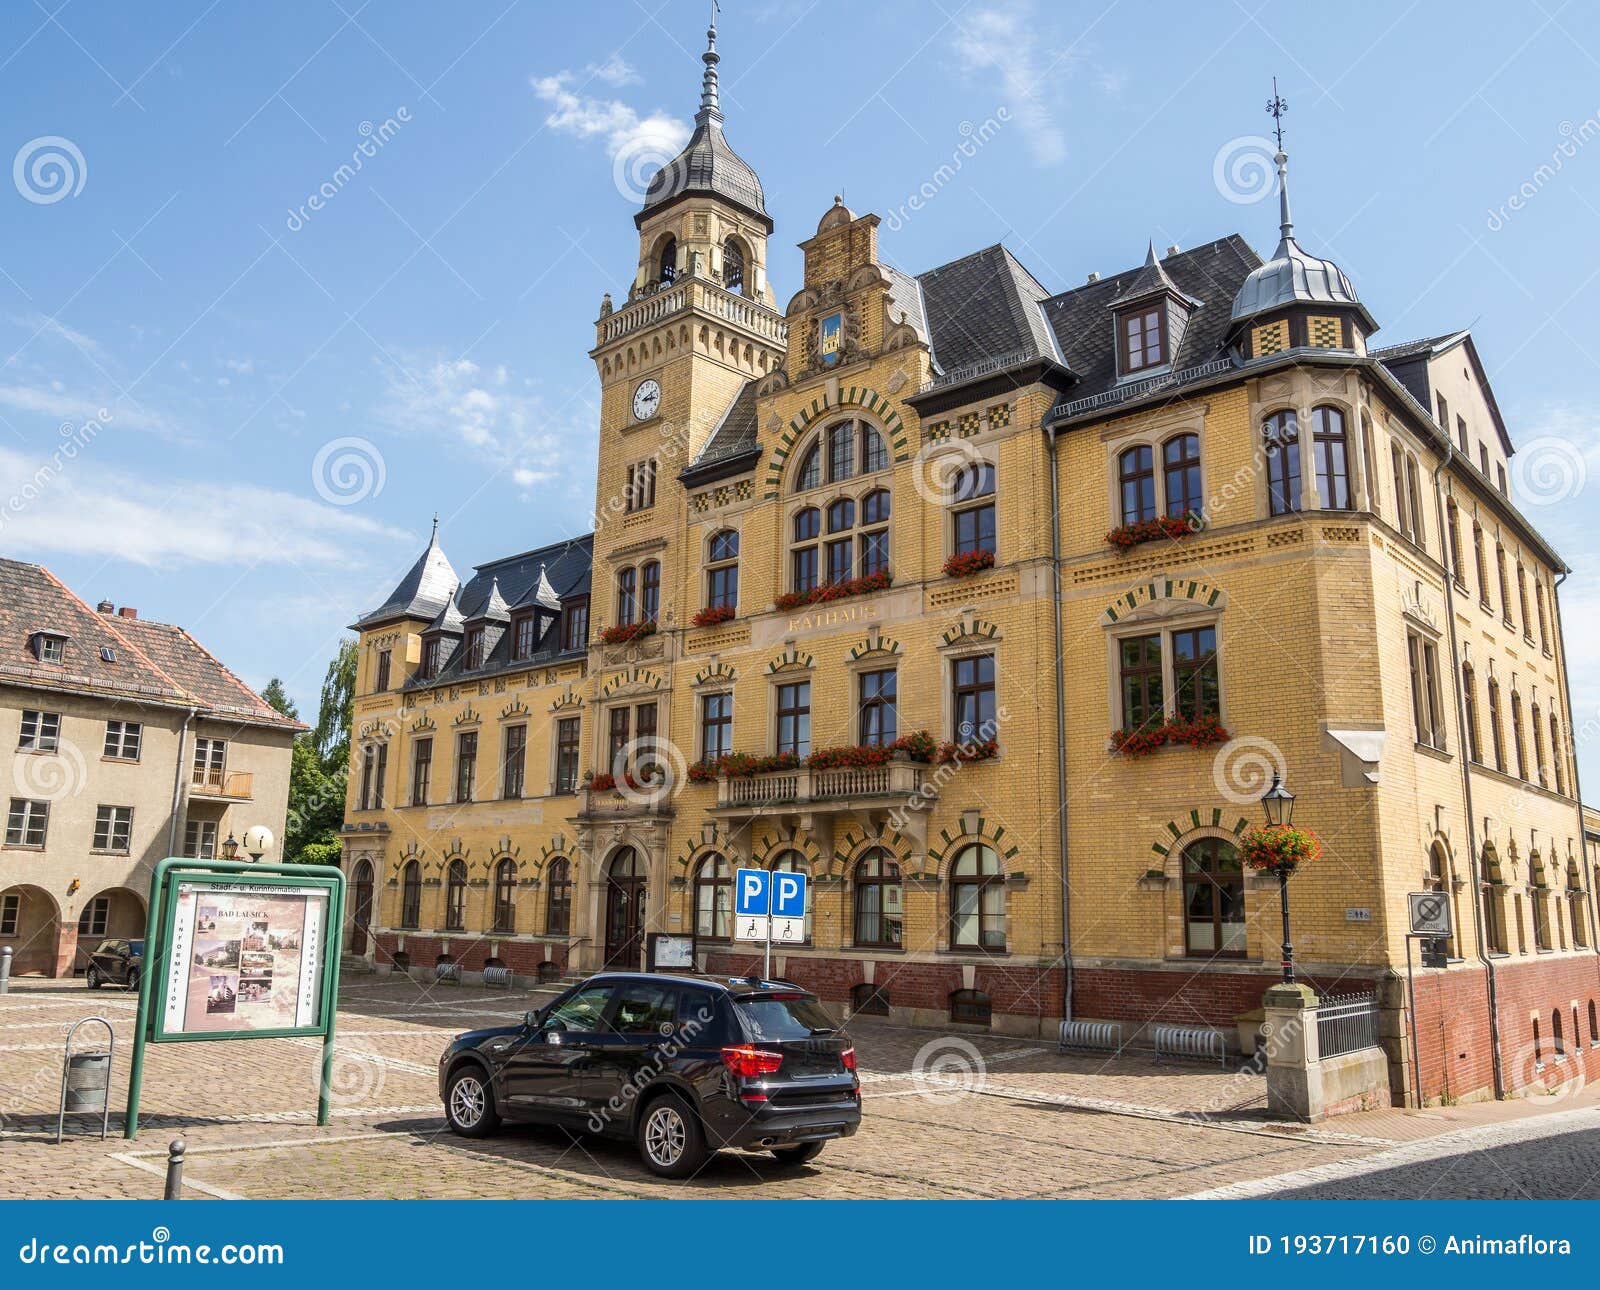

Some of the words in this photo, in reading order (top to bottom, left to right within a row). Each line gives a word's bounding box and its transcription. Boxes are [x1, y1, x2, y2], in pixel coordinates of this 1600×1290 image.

[249, 884, 301, 893] Kurinformation
[744, 875, 762, 909] P
[779, 878, 797, 911] P
[218, 910, 234, 918] BAD
